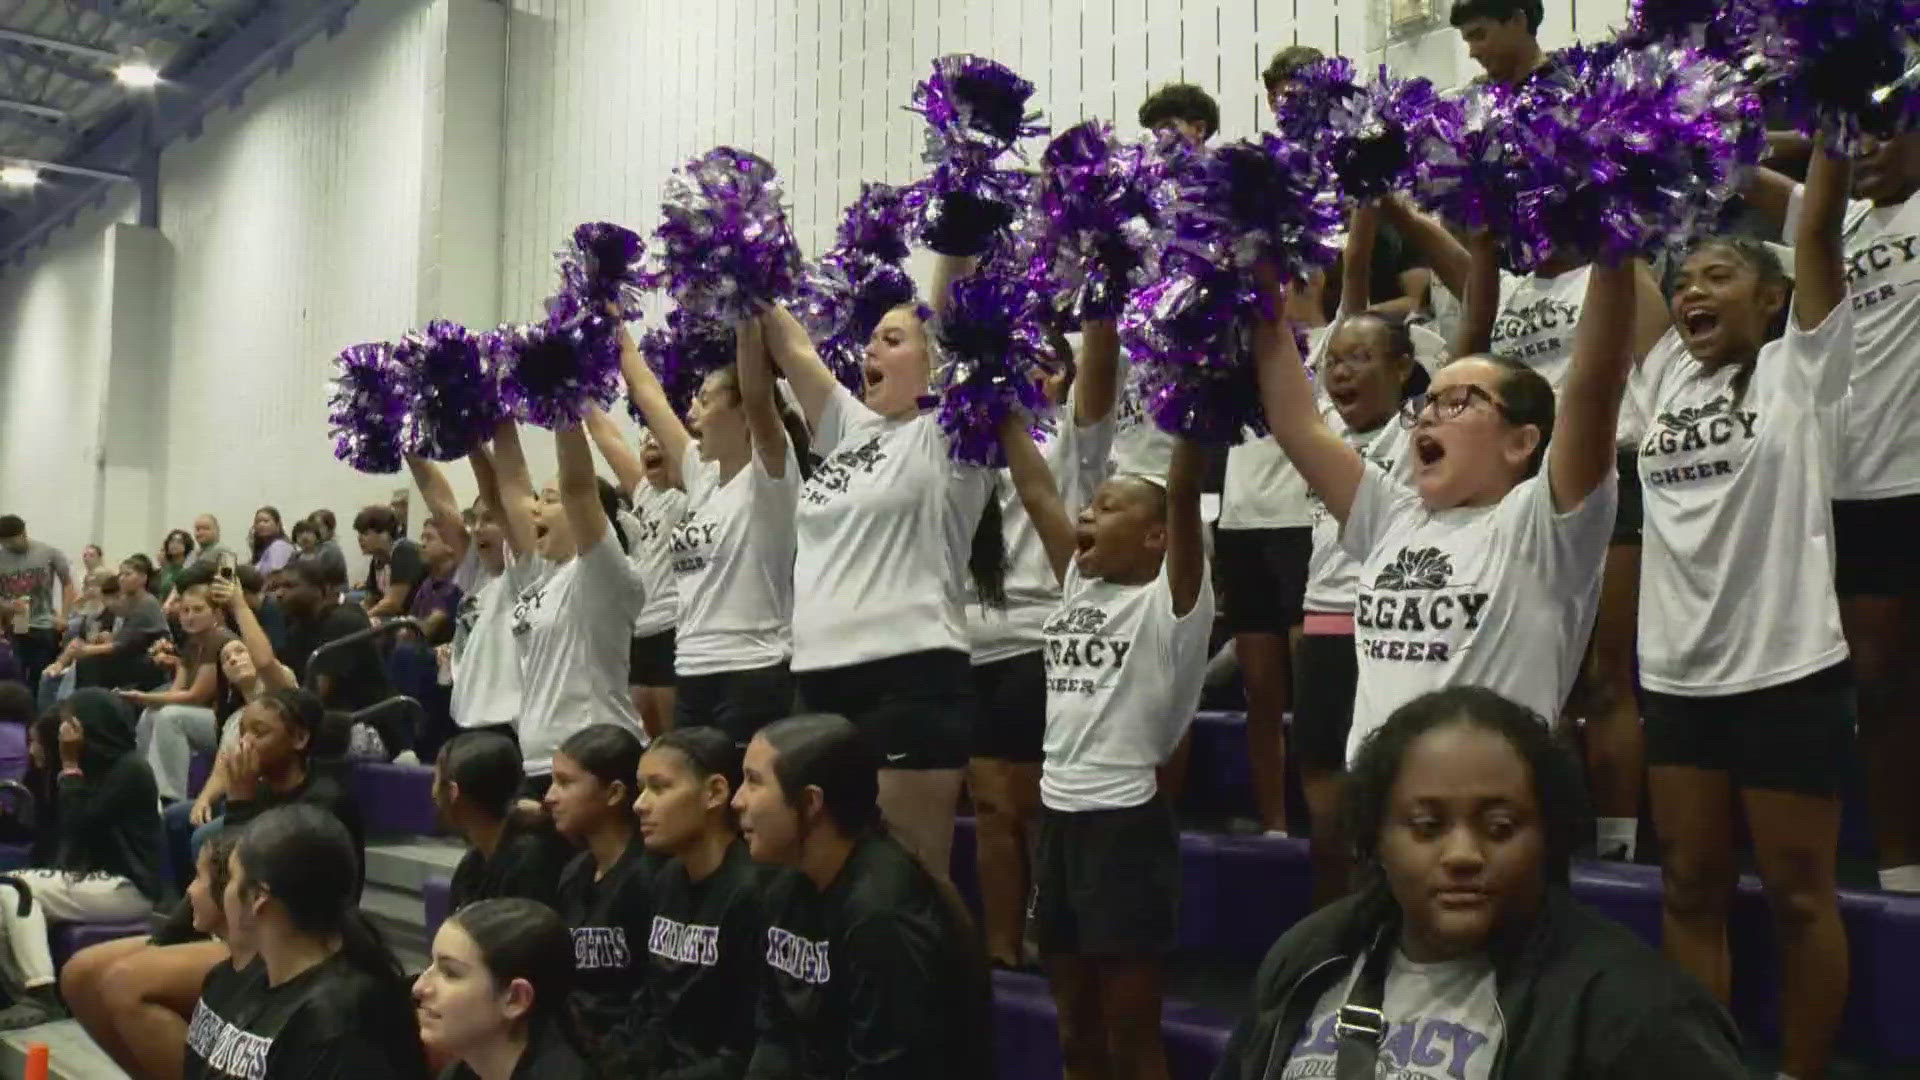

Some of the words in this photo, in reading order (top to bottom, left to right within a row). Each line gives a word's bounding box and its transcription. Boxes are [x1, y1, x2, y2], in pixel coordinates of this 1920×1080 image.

[1490, 299, 1578, 342] EGACY
[1650, 460, 1733, 485] CHEER
[1357, 593, 1489, 631] EGACY
